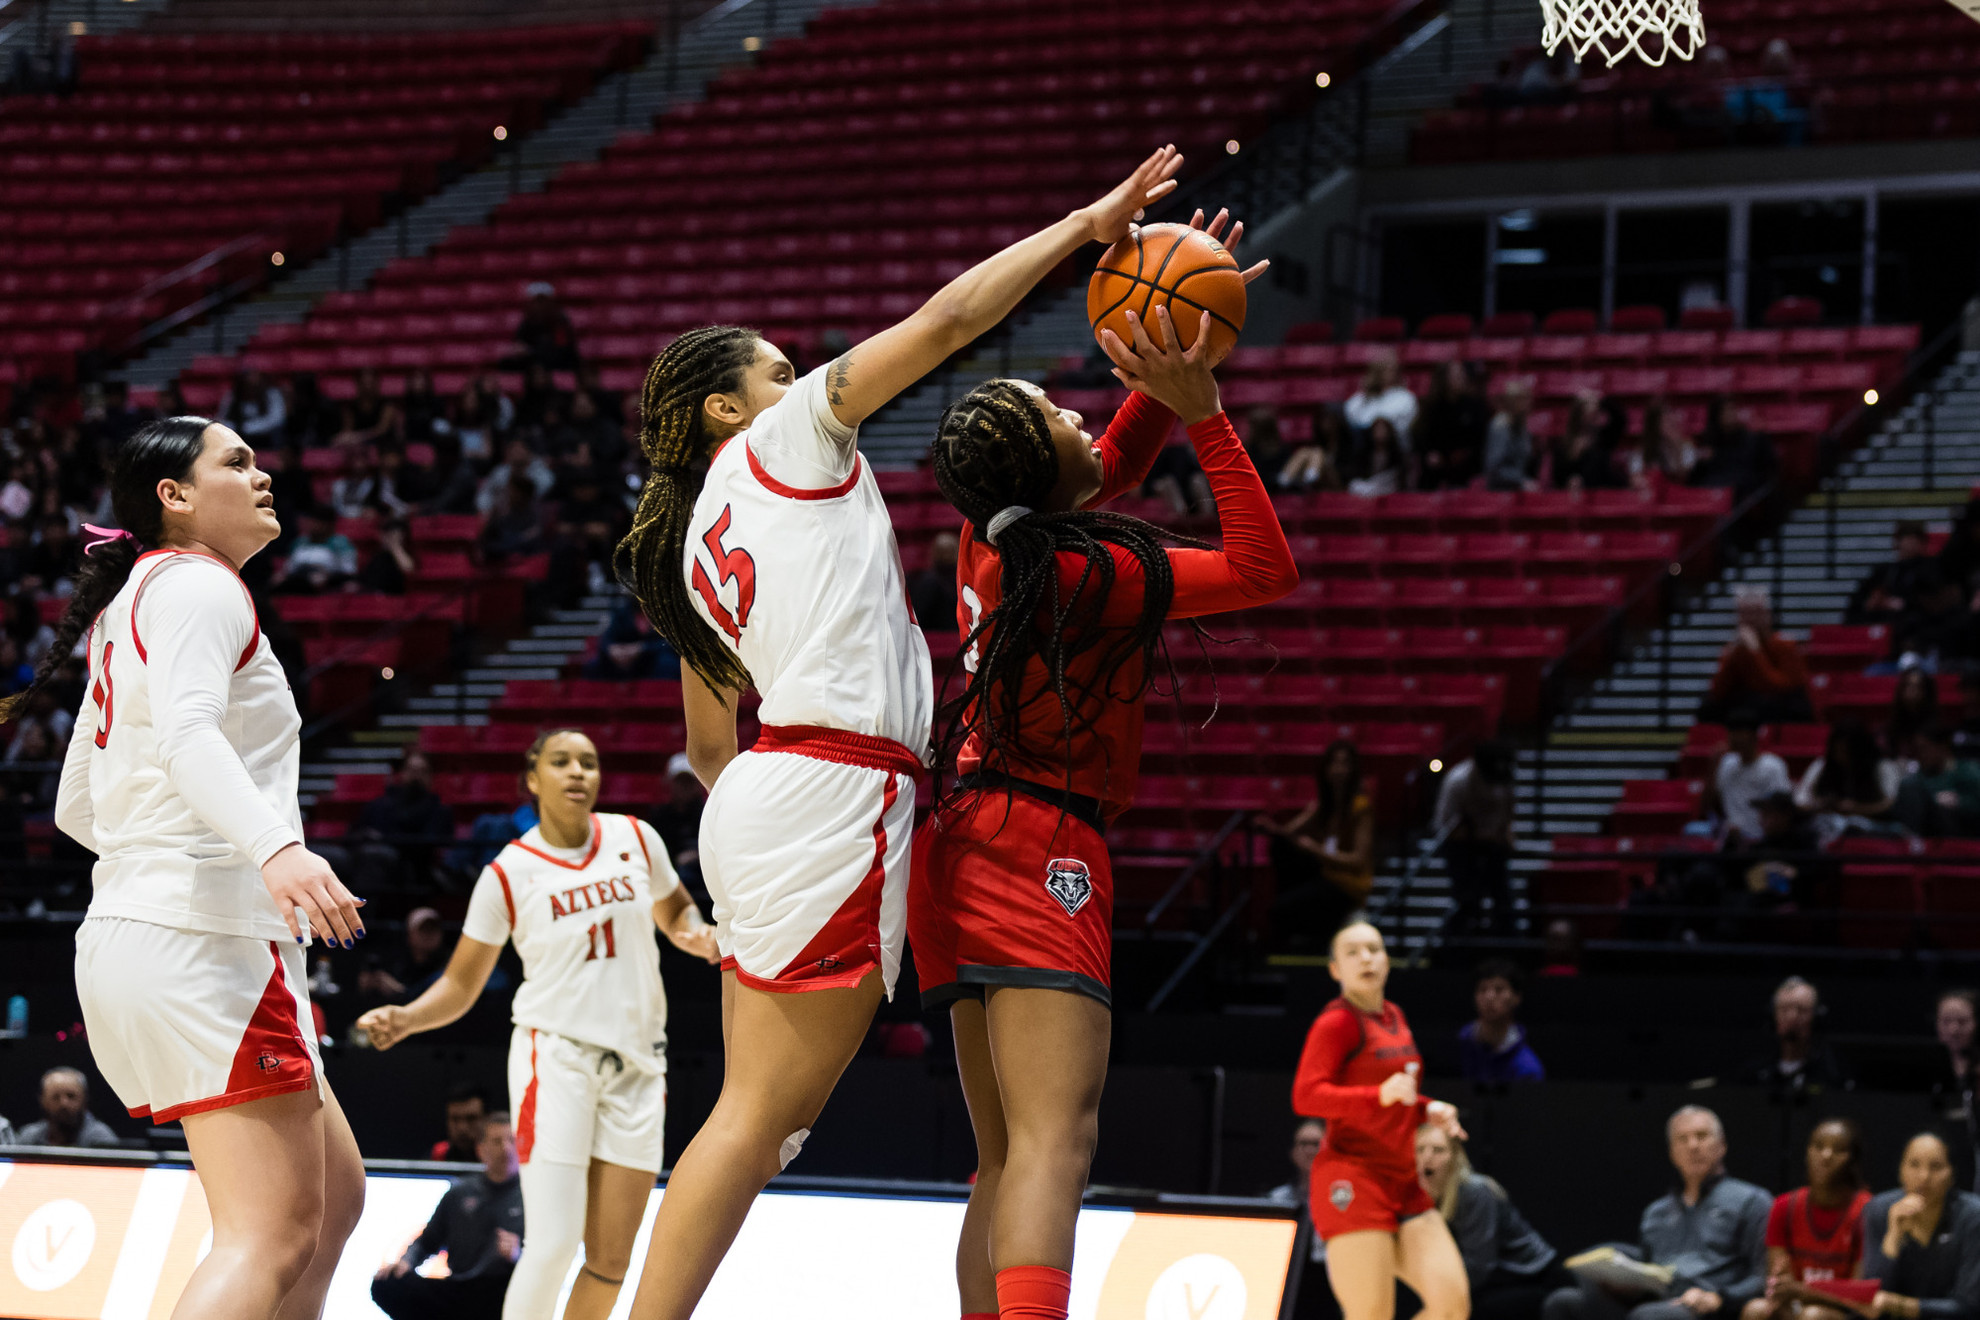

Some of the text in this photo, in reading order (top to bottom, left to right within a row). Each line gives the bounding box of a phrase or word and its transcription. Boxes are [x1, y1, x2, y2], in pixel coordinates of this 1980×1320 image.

[692, 502, 756, 649] 15
[549, 875, 635, 921] AZTECS
[585, 917, 616, 961] 11
